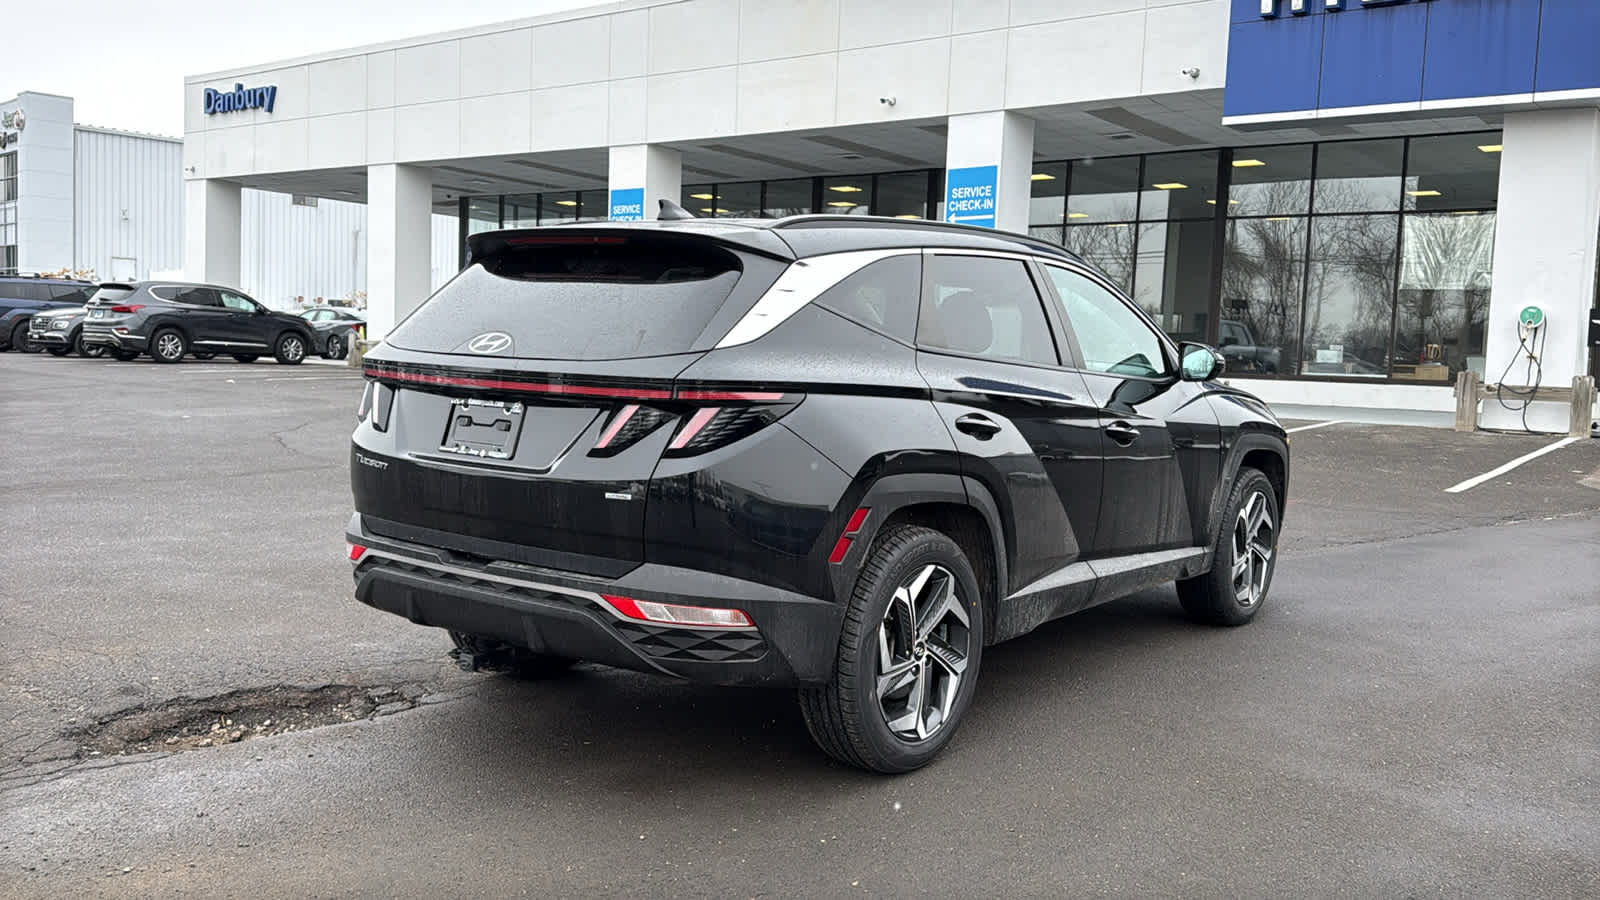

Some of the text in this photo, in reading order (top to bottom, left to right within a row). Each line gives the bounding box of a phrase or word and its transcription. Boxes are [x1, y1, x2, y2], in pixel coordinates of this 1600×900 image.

[204, 82, 277, 114] Danbury
[952, 185, 992, 199] SERVICE
[613, 203, 641, 215] SERVICE
[949, 197, 994, 212] CHECK-IN
[356, 452, 388, 470] TUCSON
